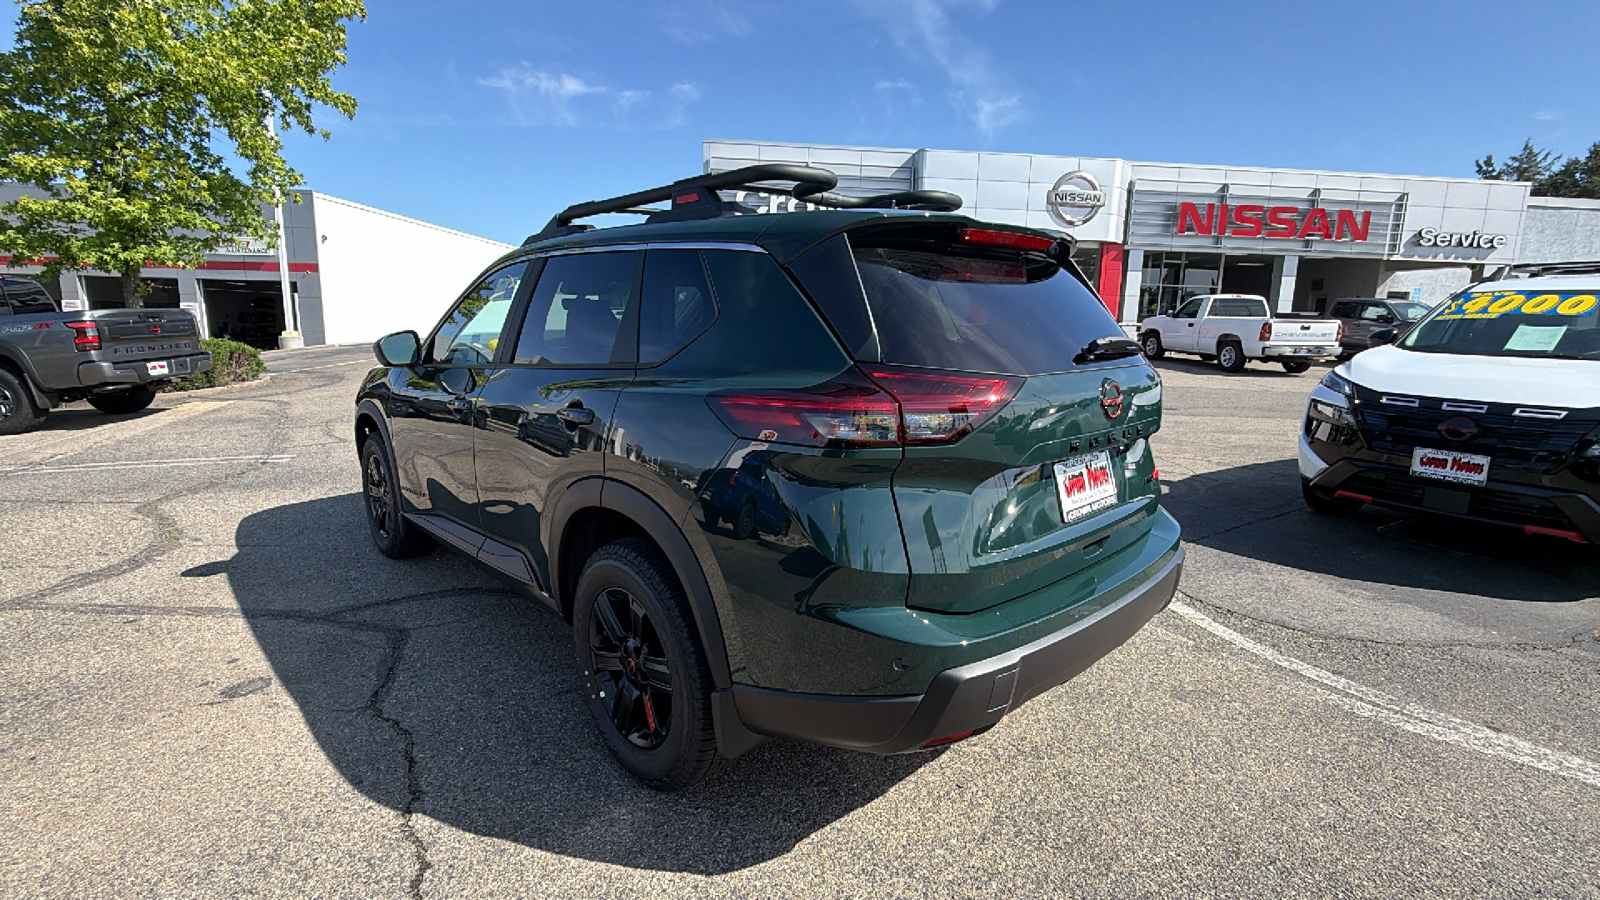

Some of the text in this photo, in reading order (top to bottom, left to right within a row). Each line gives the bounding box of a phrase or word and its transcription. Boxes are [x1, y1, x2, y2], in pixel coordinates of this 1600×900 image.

[1054, 192, 1102, 203] NISSAN
[1177, 201, 1372, 242] NISSAN
[1418, 226, 1507, 249] Service
[1444, 294, 1598, 315] $4000
[113, 342, 191, 354] FRONTIER
[1069, 425, 1143, 453] ROGUE
[1415, 471, 1443, 480] CROWN
